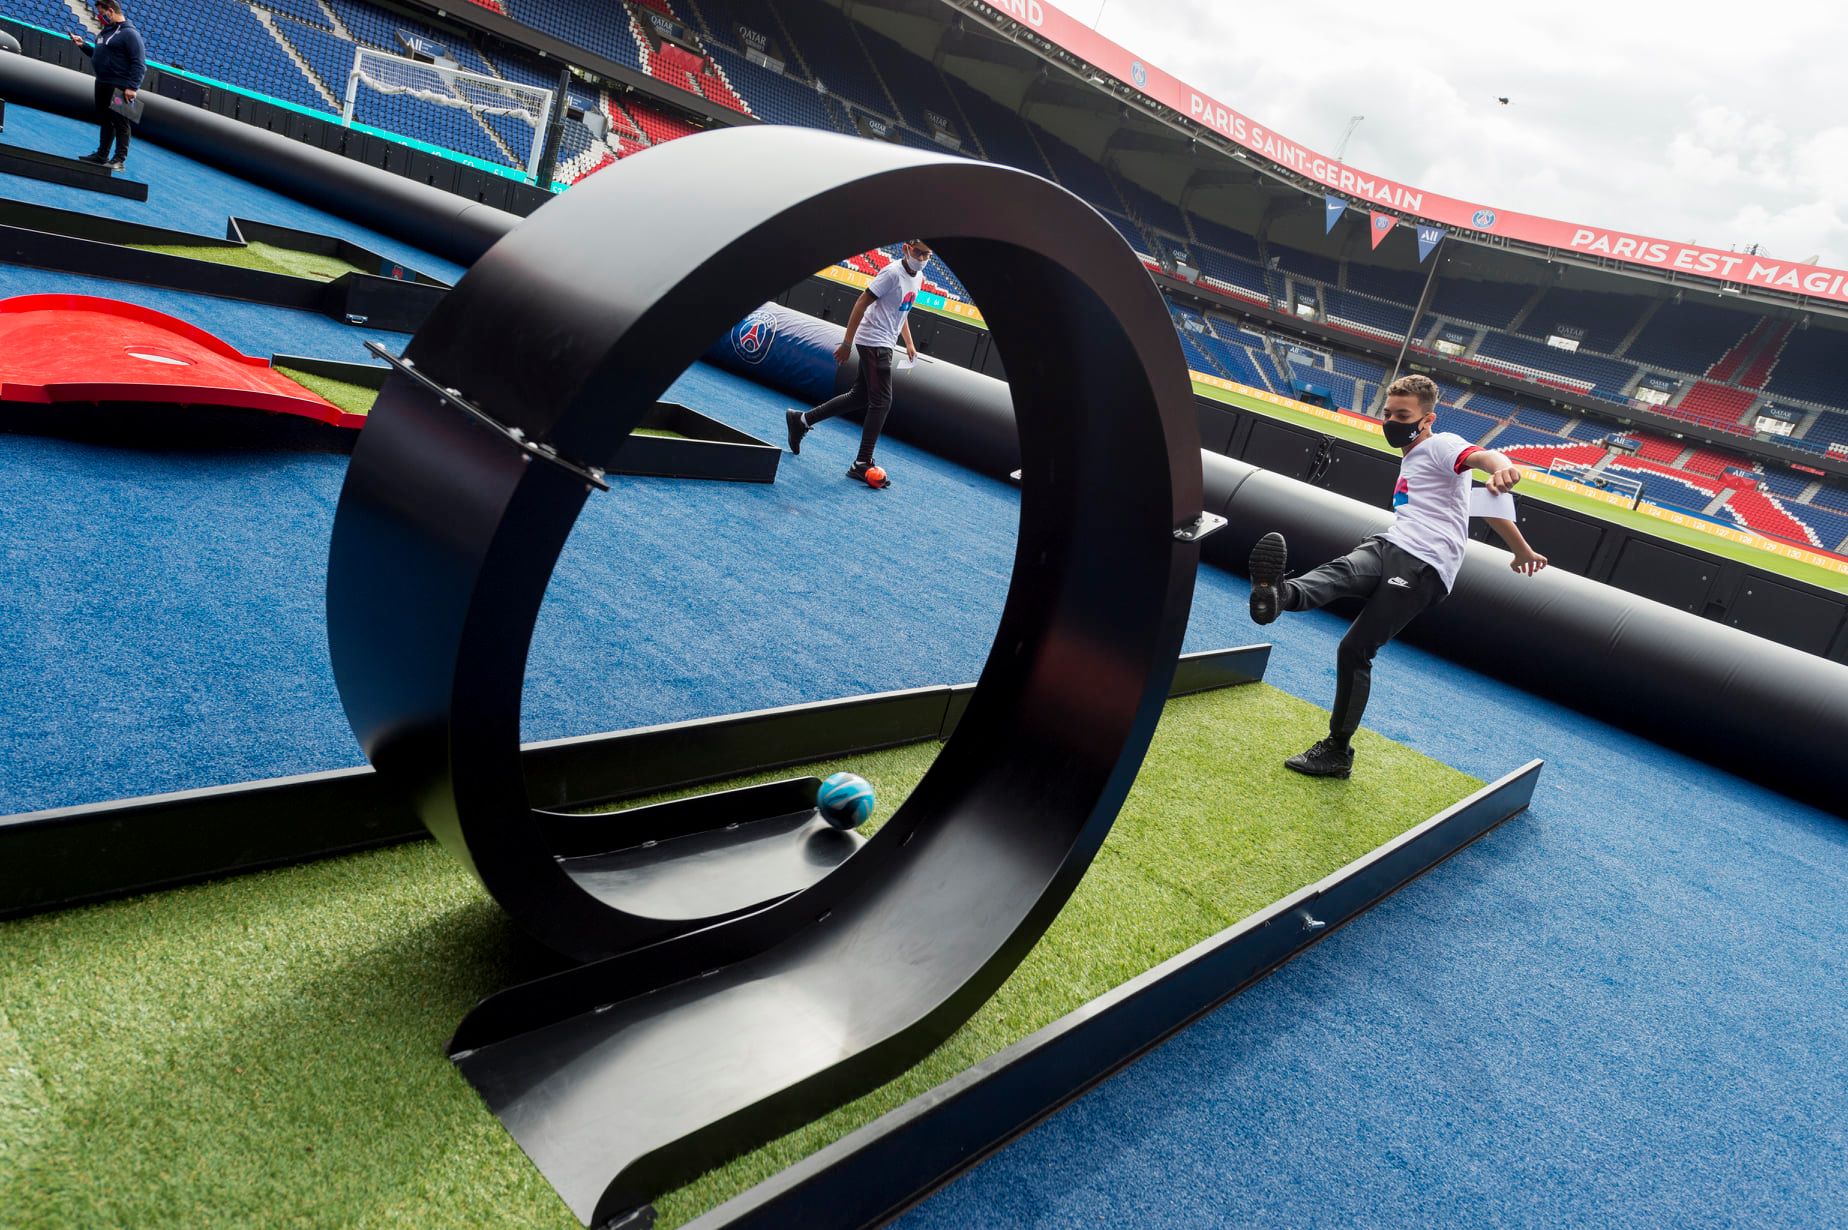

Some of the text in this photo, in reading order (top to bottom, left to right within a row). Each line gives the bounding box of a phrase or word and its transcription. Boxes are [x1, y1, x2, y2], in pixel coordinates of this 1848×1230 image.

[651, 15, 673, 30] QATAR
[1003, 0, 1043, 28] ND
[739, 26, 767, 46] QATAR
[869, 120, 887, 132] QATAR
[1190, 95, 1423, 211] PARIS SAINT-GERMAIN
[1570, 229, 1668, 263] PARIS
[1673, 249, 1743, 276] EST
[1557, 325, 1584, 337] QATAR
[1770, 408, 1792, 417] QATAR
